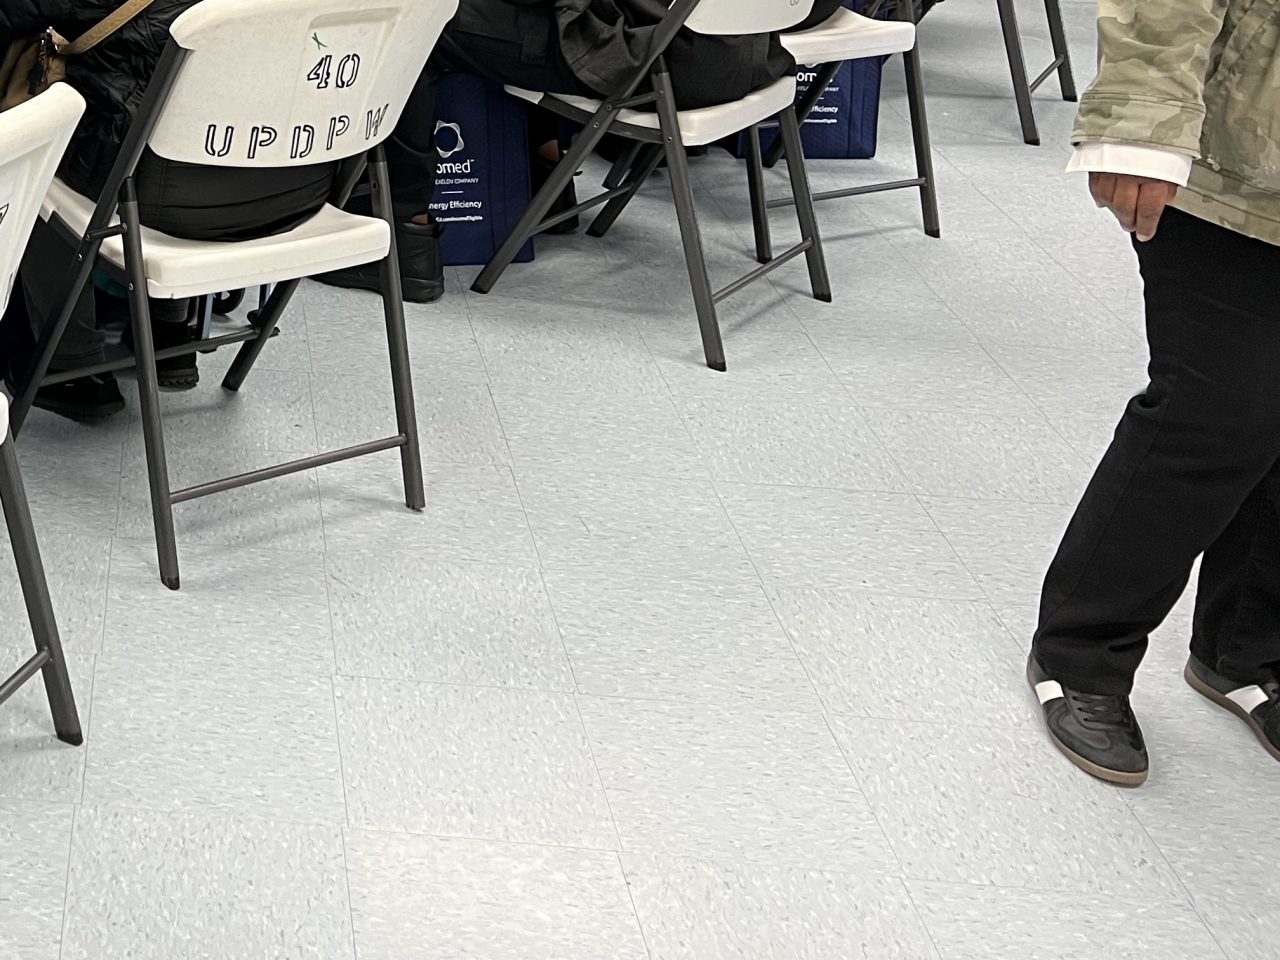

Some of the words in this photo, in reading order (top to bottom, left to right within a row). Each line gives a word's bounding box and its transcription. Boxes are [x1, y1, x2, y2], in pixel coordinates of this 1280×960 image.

[307, 53, 361, 89] 40
[436, 159, 470, 173] omed
[428, 202, 448, 210] nergy
